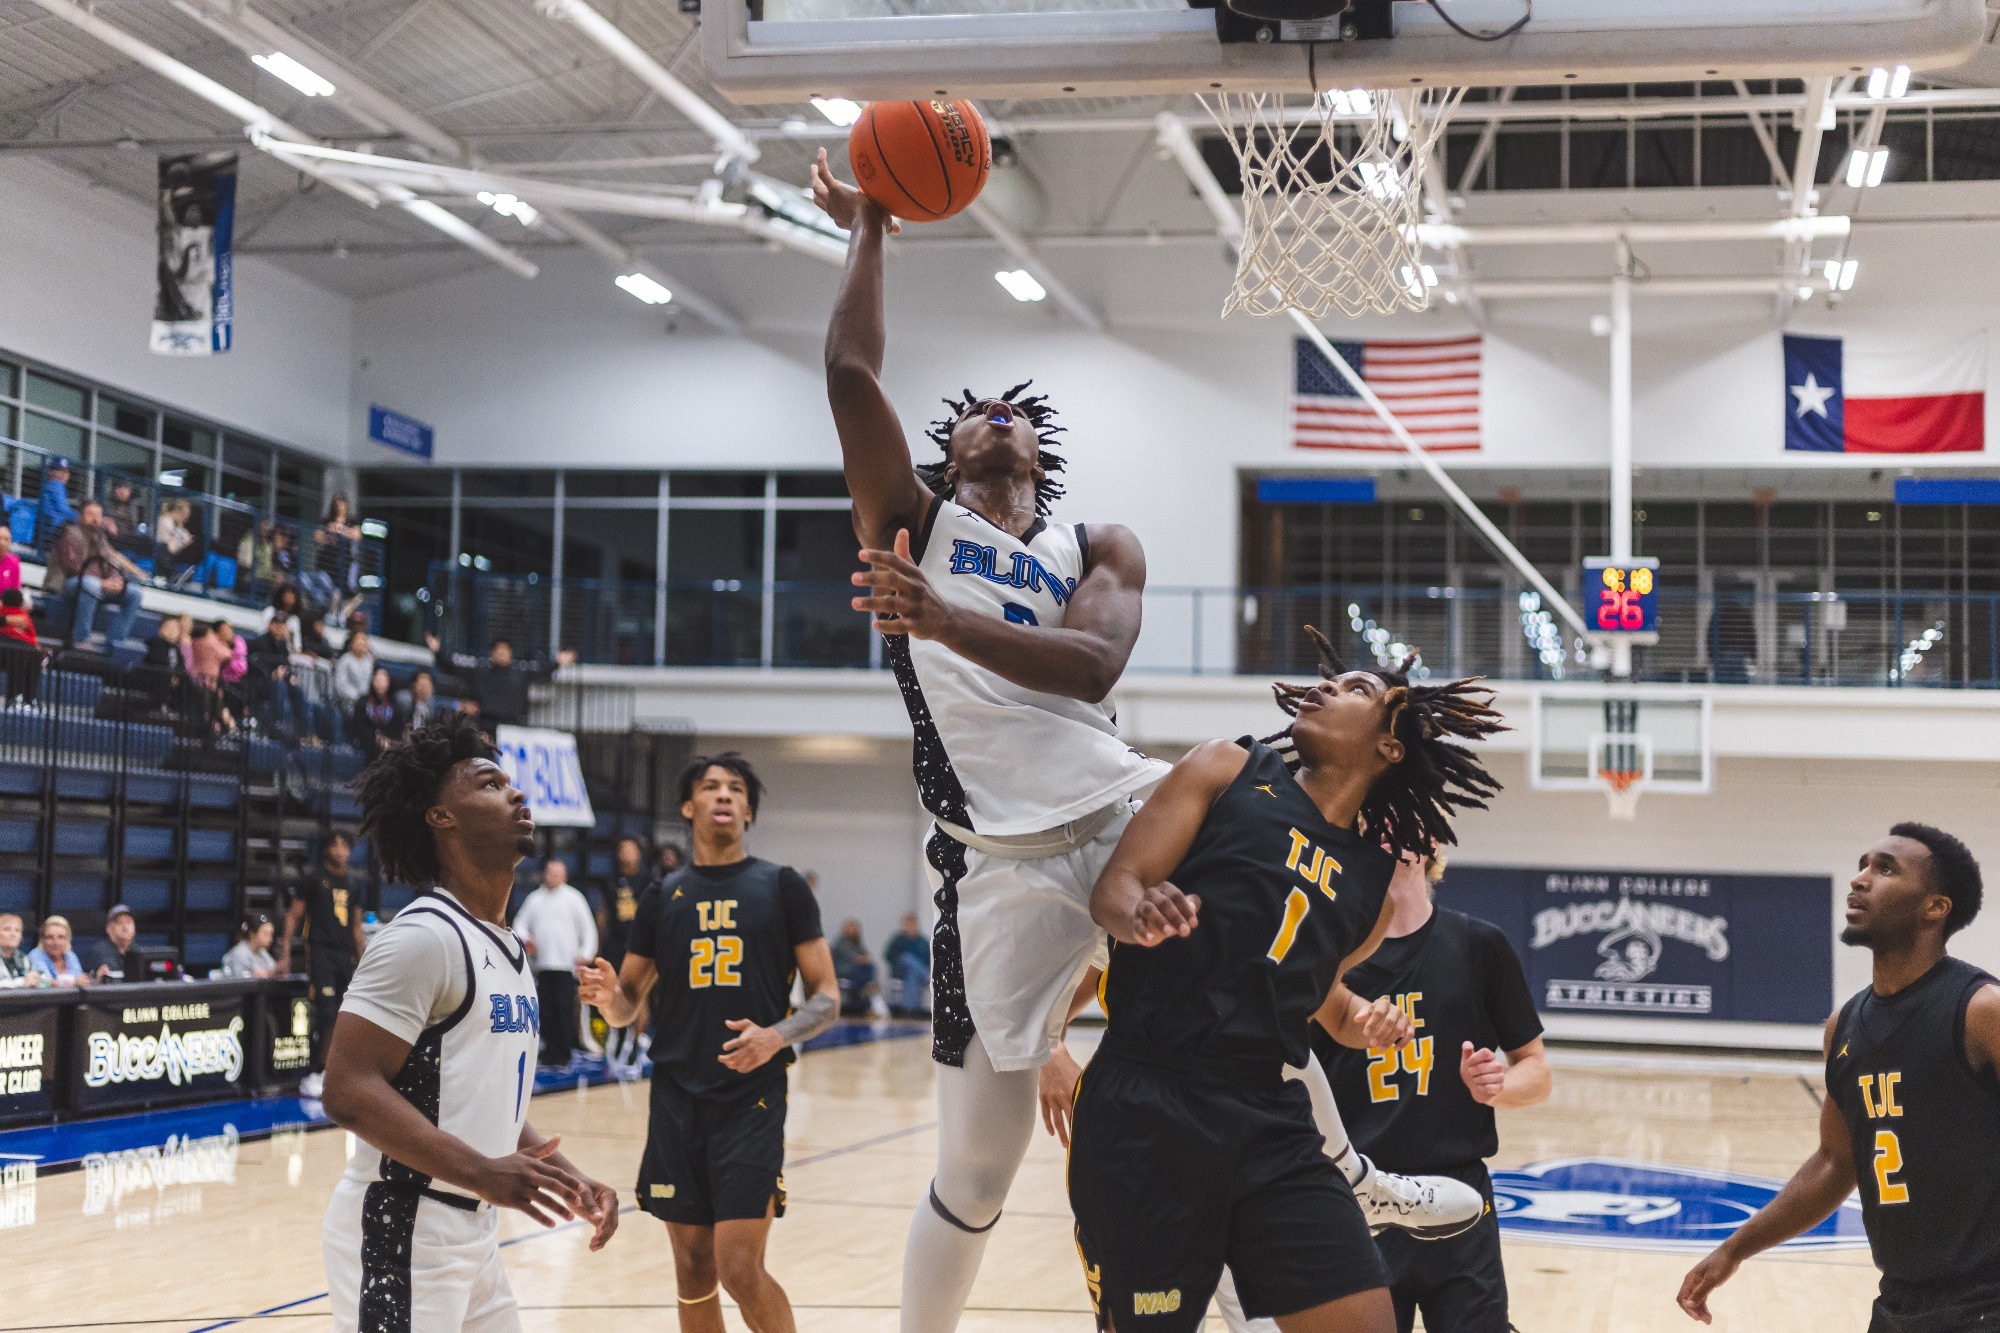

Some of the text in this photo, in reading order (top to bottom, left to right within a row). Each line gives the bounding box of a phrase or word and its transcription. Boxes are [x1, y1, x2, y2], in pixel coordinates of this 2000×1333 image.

[949, 539, 1077, 607] BLINN
[1598, 590, 1644, 631] 26
[1286, 827, 1342, 901] TJC
[1546, 874, 1711, 897] BLINN COLLEGE
[696, 899, 738, 932] TJC
[1266, 886, 1310, 965] 1
[1529, 895, 1731, 962] BUCCANEERS
[689, 935, 744, 990] 22
[122, 1003, 210, 1024] BLINN COLLEGE
[489, 994, 540, 1038] BLIN
[1546, 984, 1711, 1009] ATHLETICS
[84, 1015, 245, 1087] BUCCANEERS
[1366, 1035, 1435, 1104] 24
[514, 1050, 527, 1124] 1
[1858, 1071, 1904, 1119] TJC
[1873, 1130, 1910, 1205] 2
[1133, 1288, 1181, 1315] WAG
